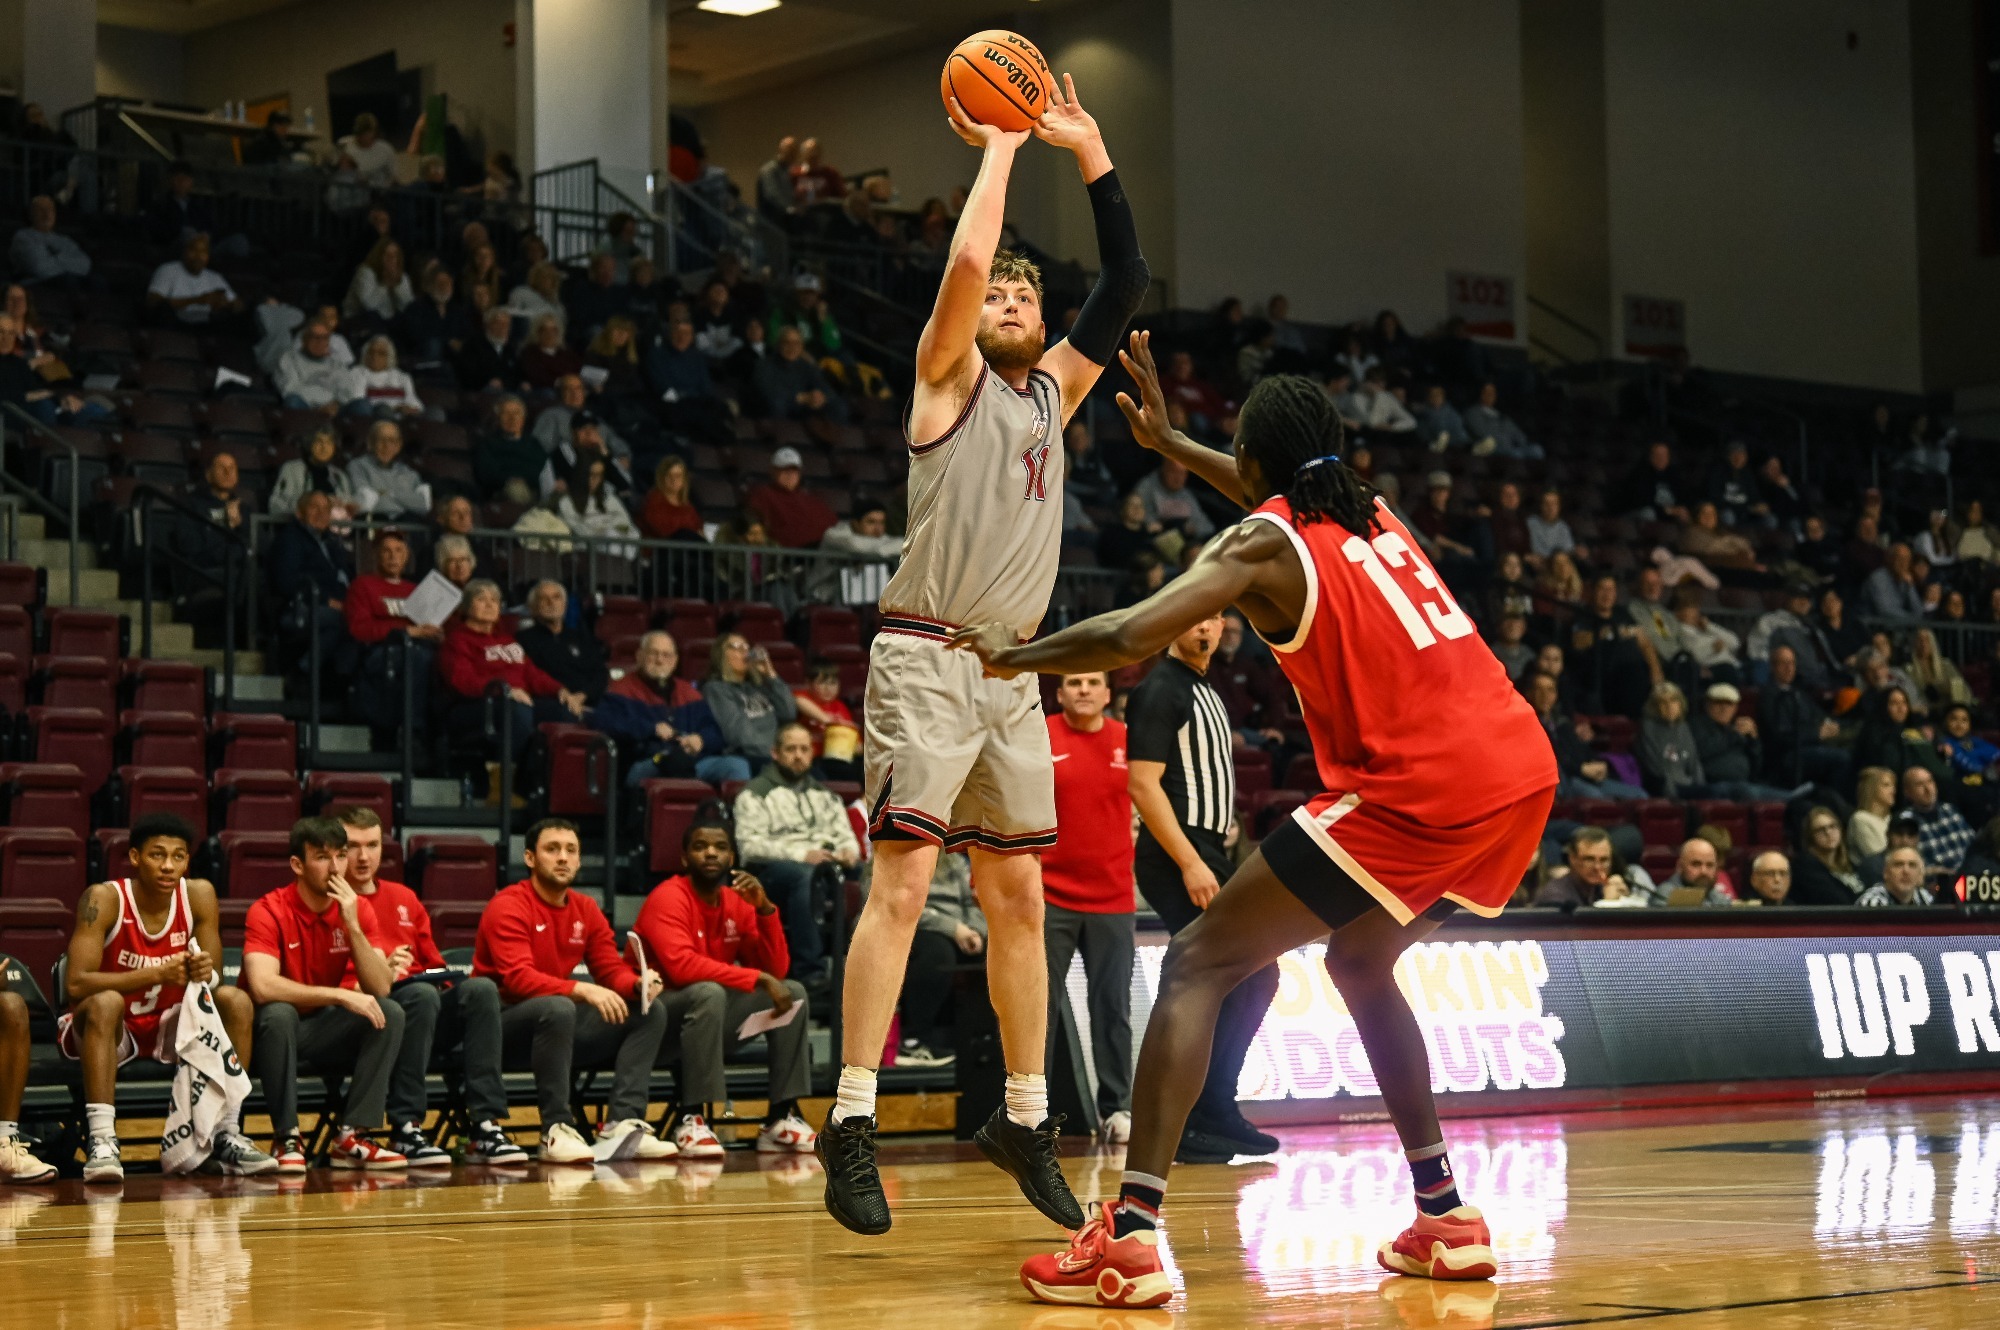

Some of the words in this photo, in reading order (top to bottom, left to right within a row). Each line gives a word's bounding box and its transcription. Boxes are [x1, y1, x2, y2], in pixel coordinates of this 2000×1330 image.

[983, 47, 1040, 107] Wilson
[1007, 35, 1047, 73] NCAA
[1457, 277, 1506, 307] 102
[1633, 302, 1679, 330] 101
[1021, 445, 1050, 501] 11
[1341, 531, 1473, 650] 13
[130, 984, 162, 1015] 3
[1273, 951, 1540, 1016] DUKIN'
[1805, 952, 1931, 1059] IUP
[1282, 1021, 1557, 1090] DOUTS
